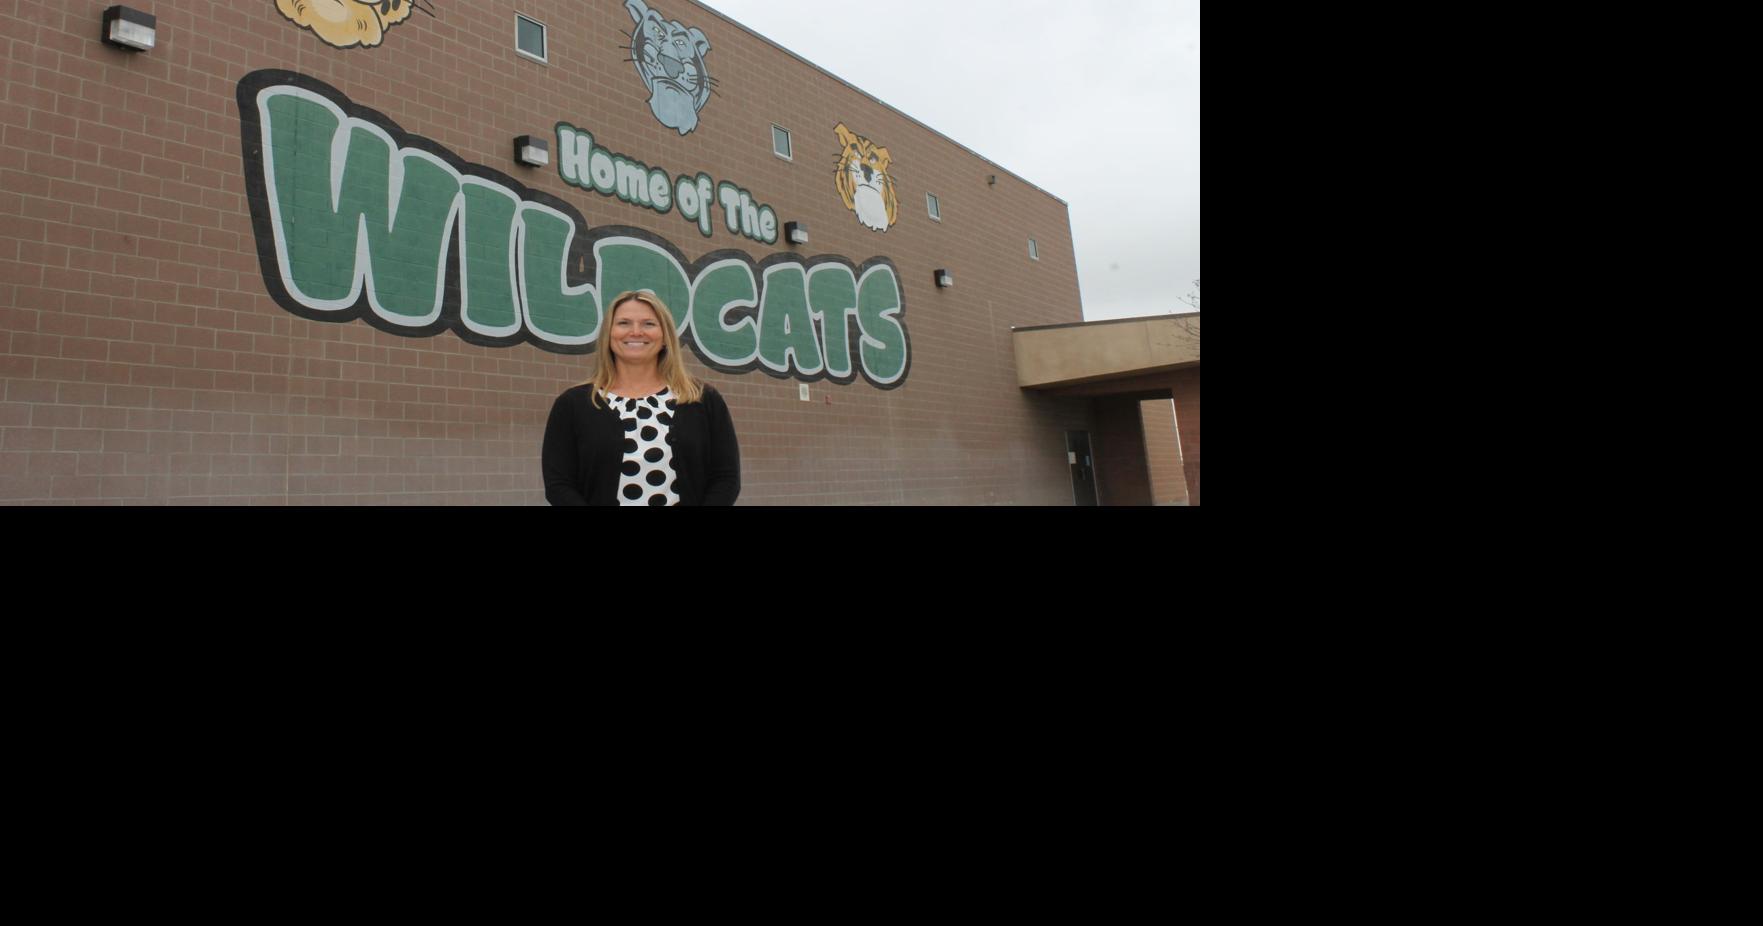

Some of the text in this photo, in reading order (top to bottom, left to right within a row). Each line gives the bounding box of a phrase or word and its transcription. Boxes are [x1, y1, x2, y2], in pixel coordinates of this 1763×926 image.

[256, 84, 906, 385] WILDCATS
[557, 125, 777, 243] Home of The
